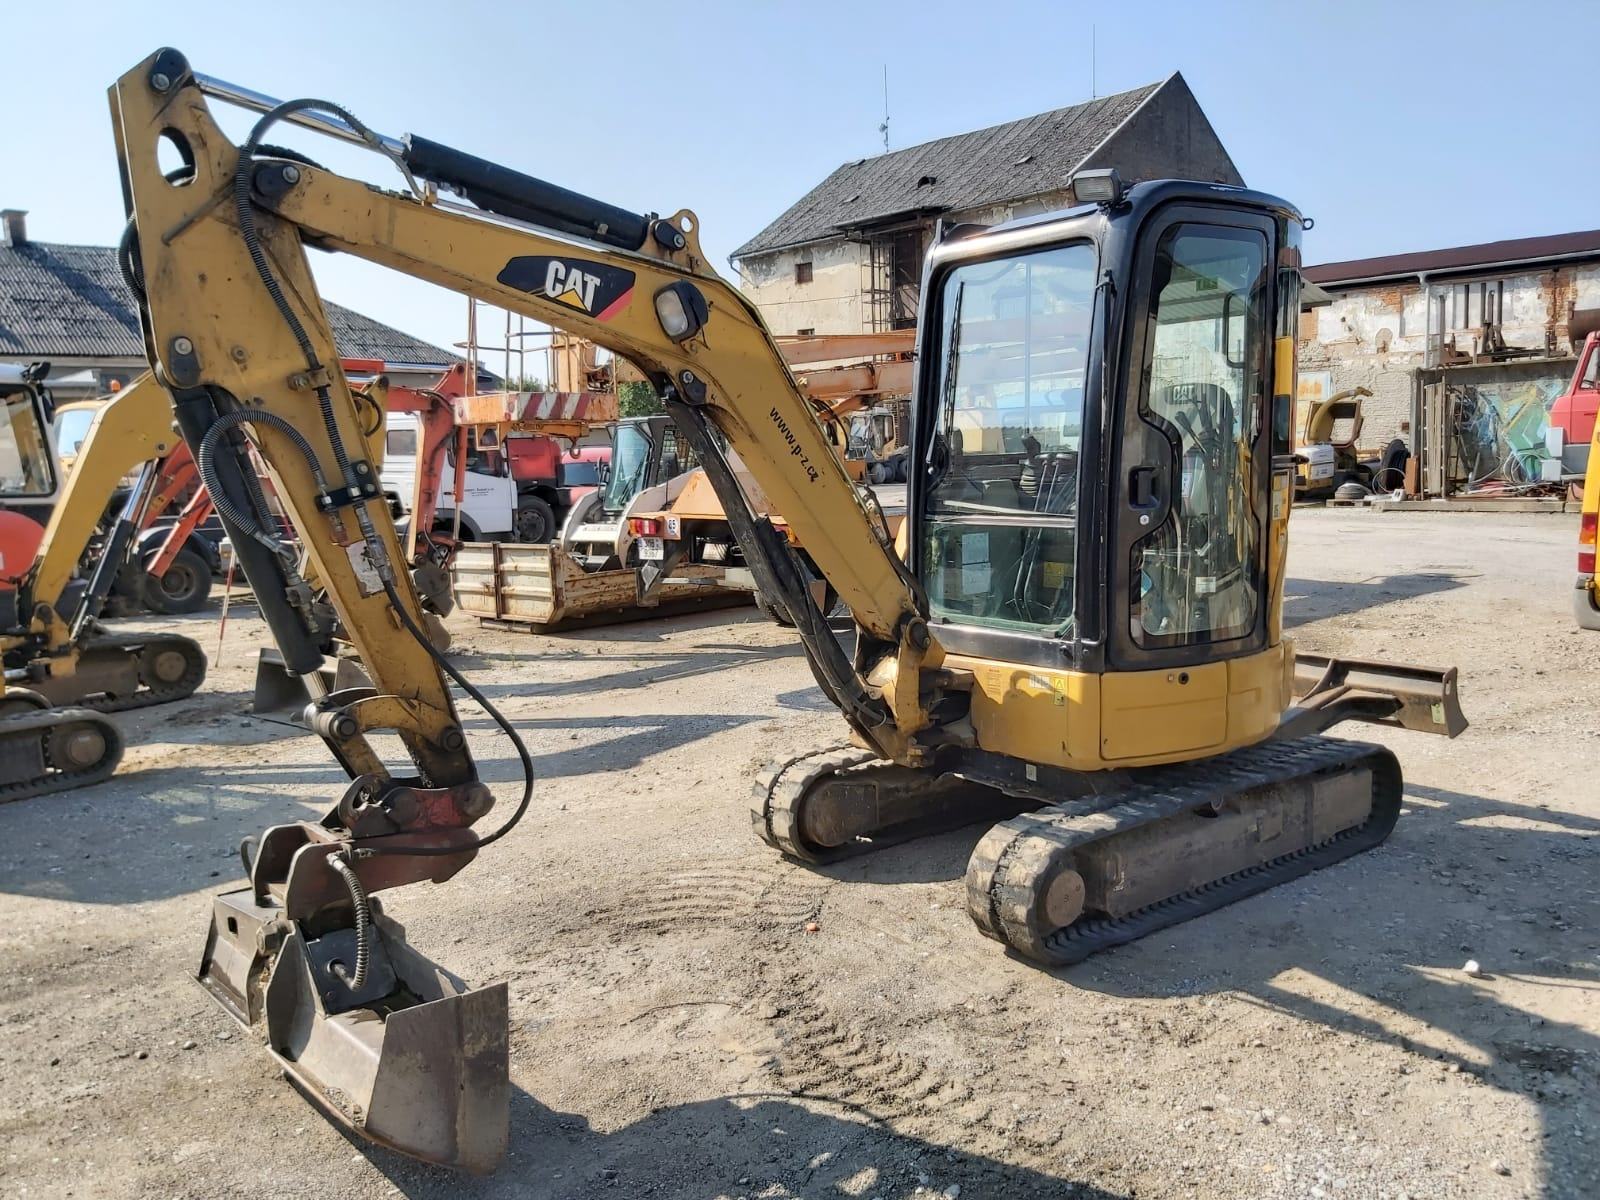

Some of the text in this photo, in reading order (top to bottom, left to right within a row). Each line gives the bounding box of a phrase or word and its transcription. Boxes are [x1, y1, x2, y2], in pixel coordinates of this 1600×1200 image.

[545, 260, 601, 312] CAT
[1173, 385, 1195, 401] CAT
[769, 407, 819, 483] www.p-z.cz
